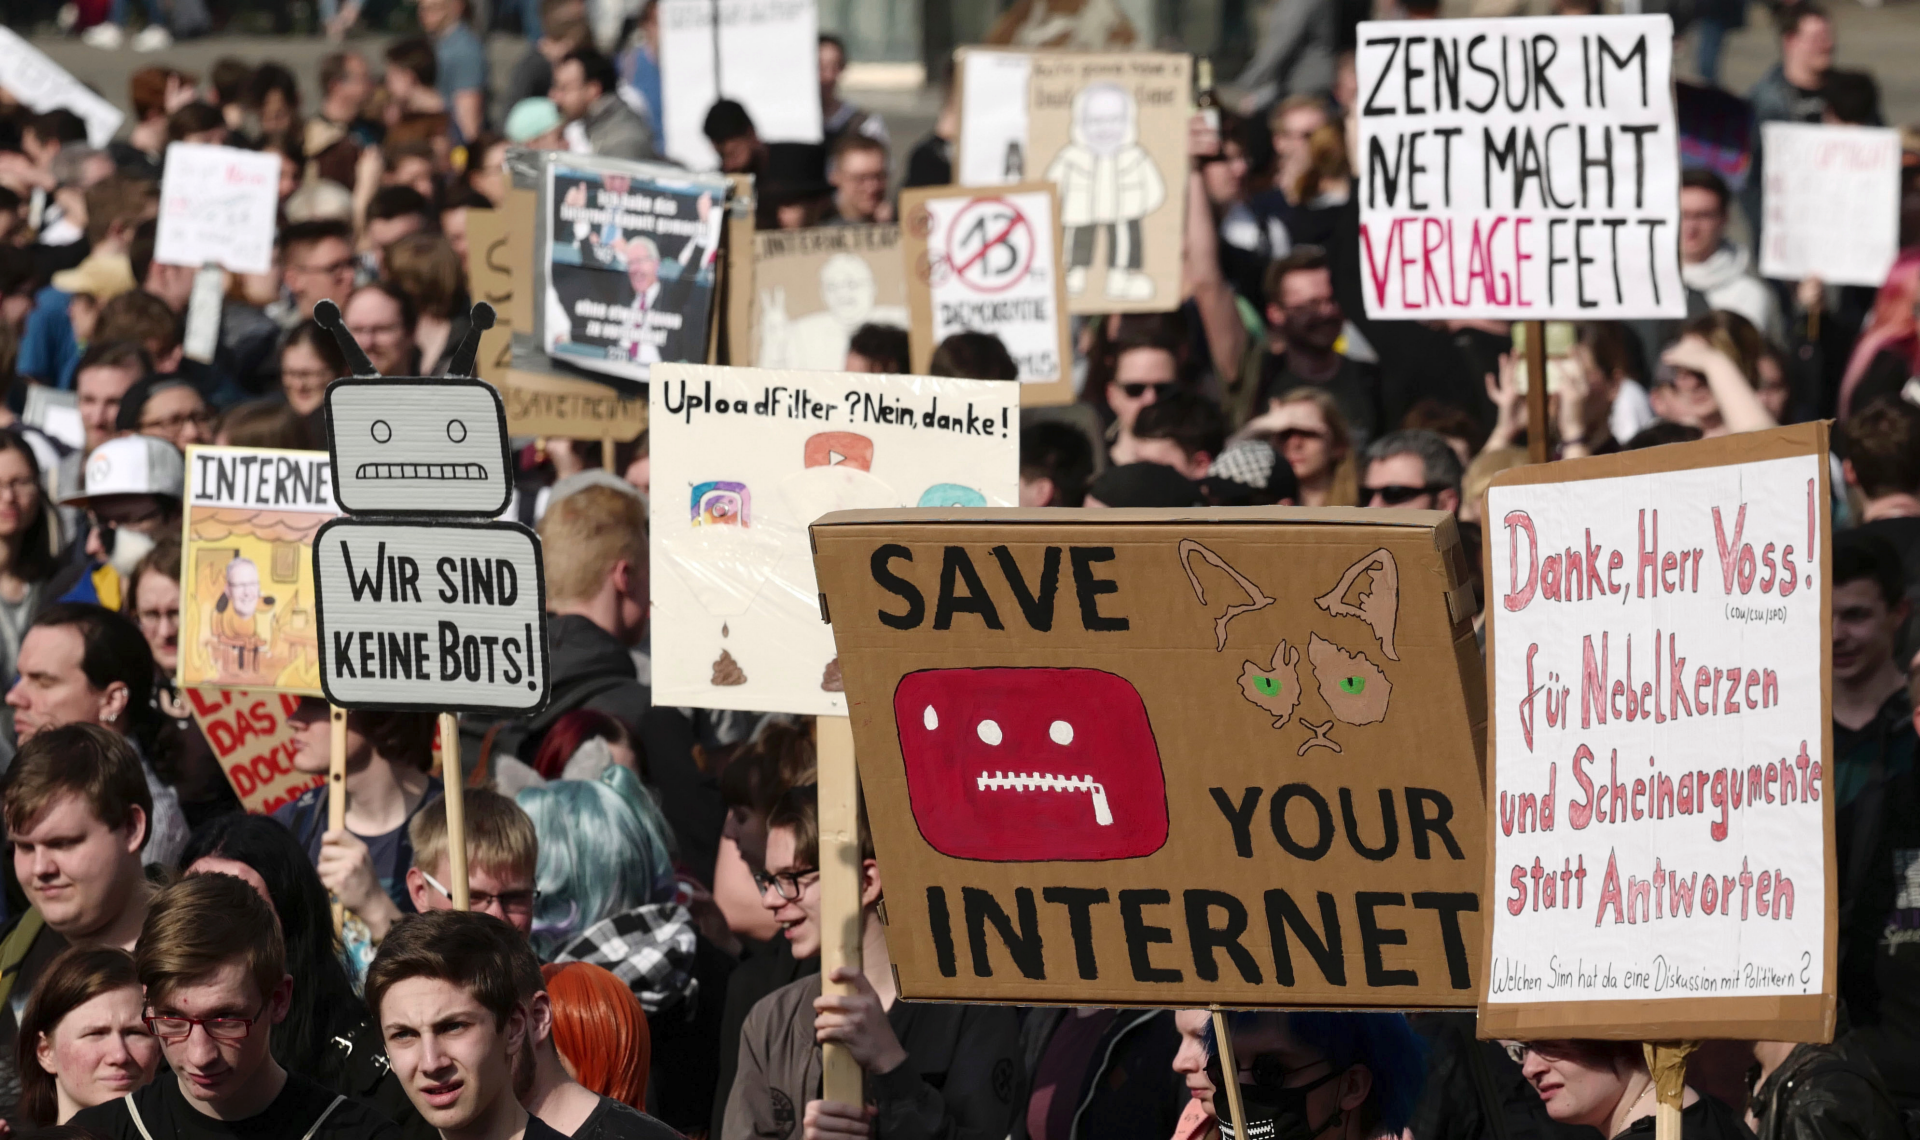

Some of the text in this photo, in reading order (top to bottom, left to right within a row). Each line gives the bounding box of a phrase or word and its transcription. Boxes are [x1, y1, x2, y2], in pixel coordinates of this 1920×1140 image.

[1364, 34, 1649, 116] ZENSUR IM
[1369, 123, 1660, 210] NET MACHT
[1359, 217, 1668, 310] VERLAGE FETT
[864, 391, 919, 430] Nein,
[195, 455, 331, 505] INTERNE
[340, 540, 519, 607] WIR SIND
[1503, 478, 1816, 612] Danke, Herr Voss!
[870, 543, 1130, 633] SAVE
[333, 620, 539, 692] KEINE BOTS!
[1519, 628, 1779, 752] für Nebelkerzen
[206, 700, 278, 758] DAS
[1209, 782, 1467, 862] YOUR
[1500, 740, 1824, 842] und Scheinargumente
[1507, 846, 1796, 928] statt Antworten
[926, 886, 1480, 990] INTERNET
[1492, 957, 1542, 994] Welchen
[1547, 954, 1573, 989] Sinn
[1577, 957, 1599, 989] hat
[1602, 961, 1617, 988] da
[1624, 961, 1650, 989] eine
[1652, 954, 1718, 992] Diskussion
[1720, 968, 1740, 990] mit
